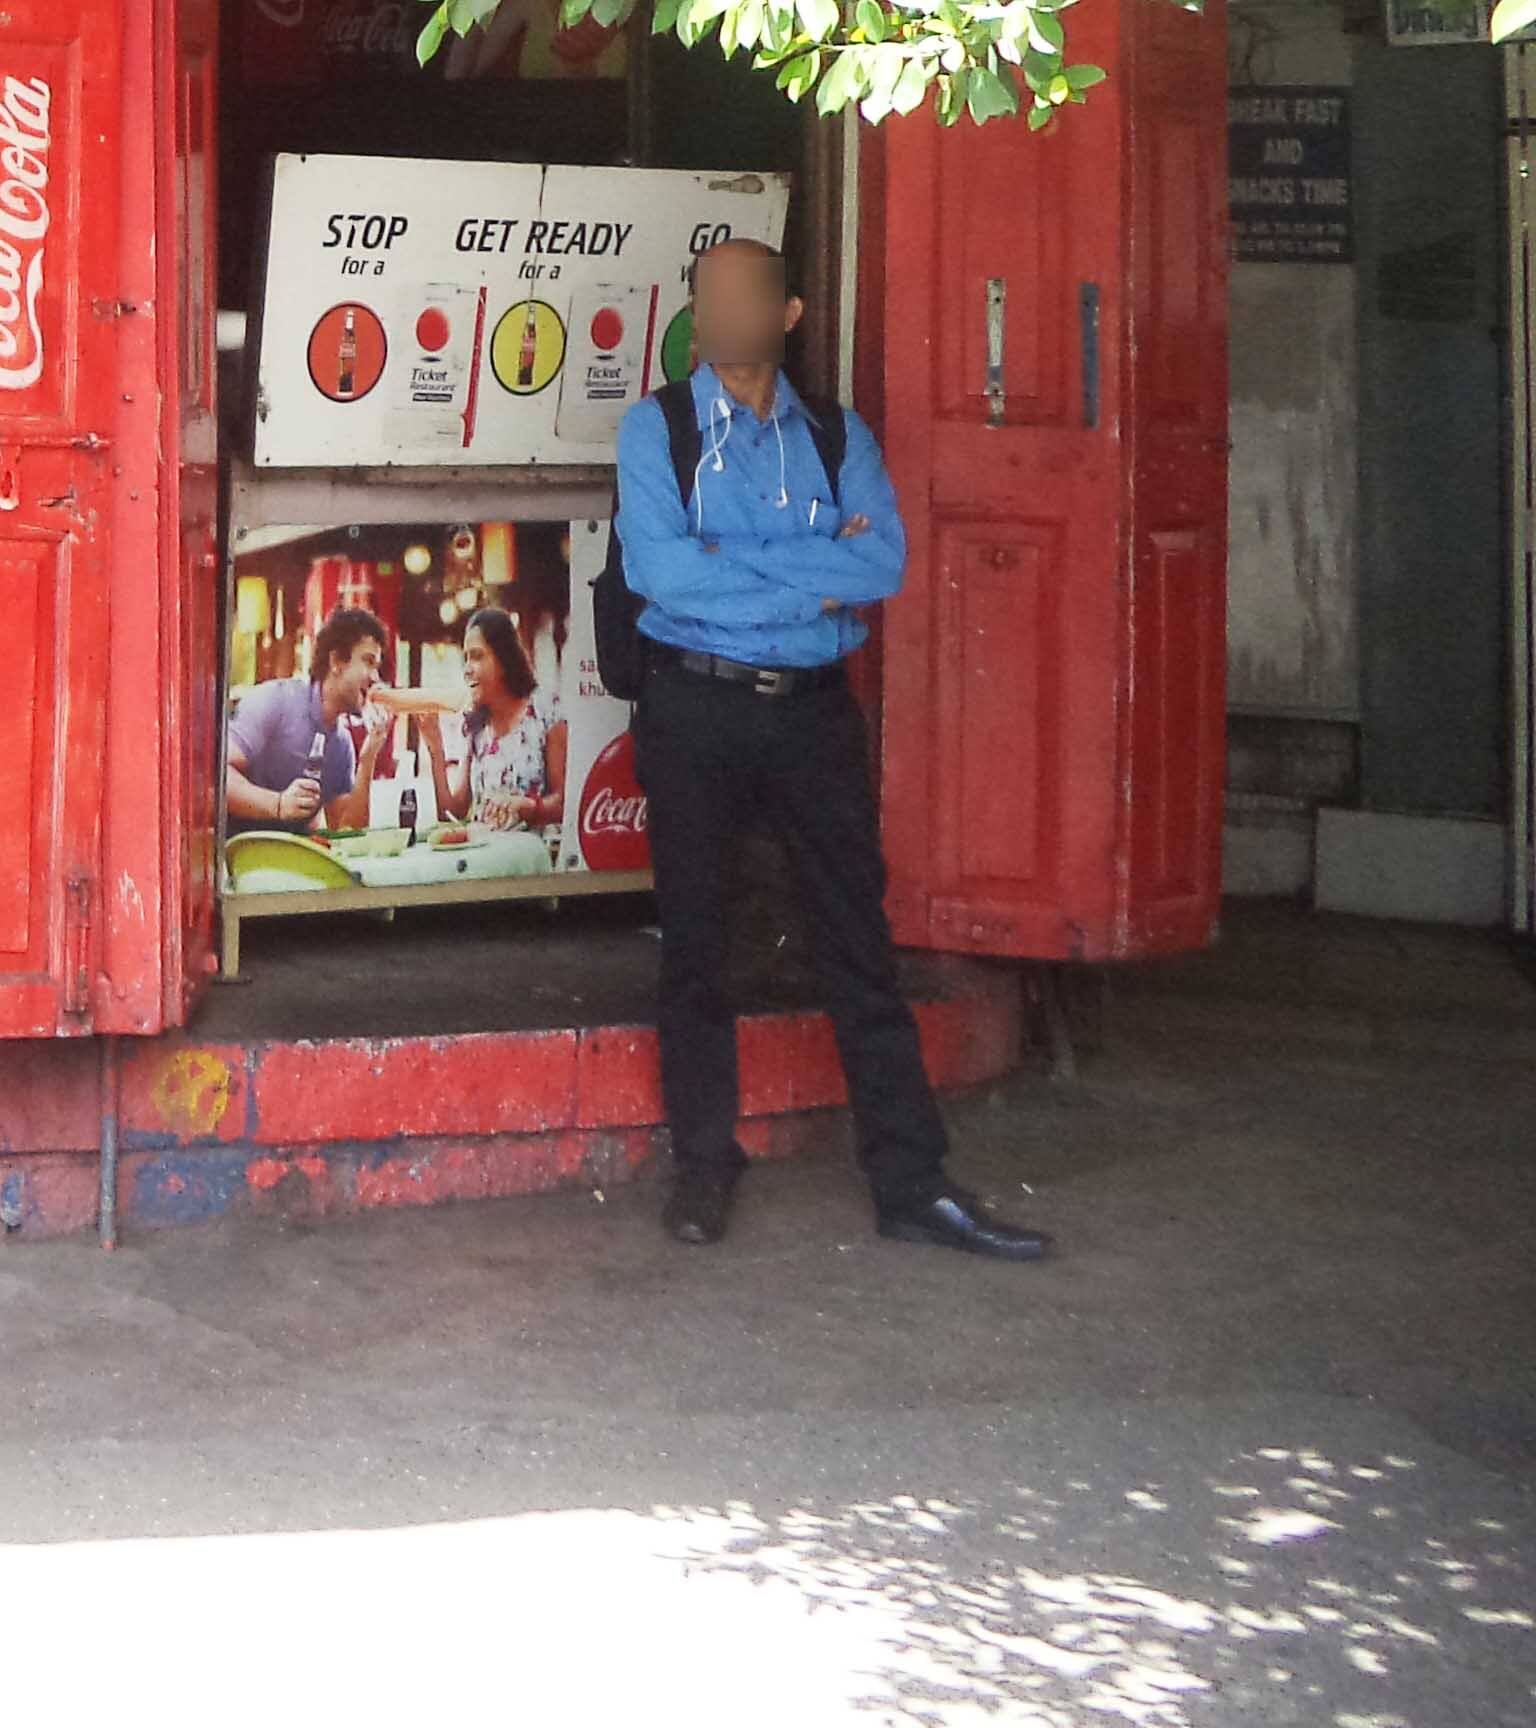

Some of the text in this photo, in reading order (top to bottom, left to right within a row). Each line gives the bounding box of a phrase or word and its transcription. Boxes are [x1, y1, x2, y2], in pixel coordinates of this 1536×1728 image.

[322, 214, 409, 250] STOP
[455, 218, 519, 253] GET
[524, 220, 633, 257] READY
[341, 255, 386, 276] for a
[518, 260, 562, 280] for a
